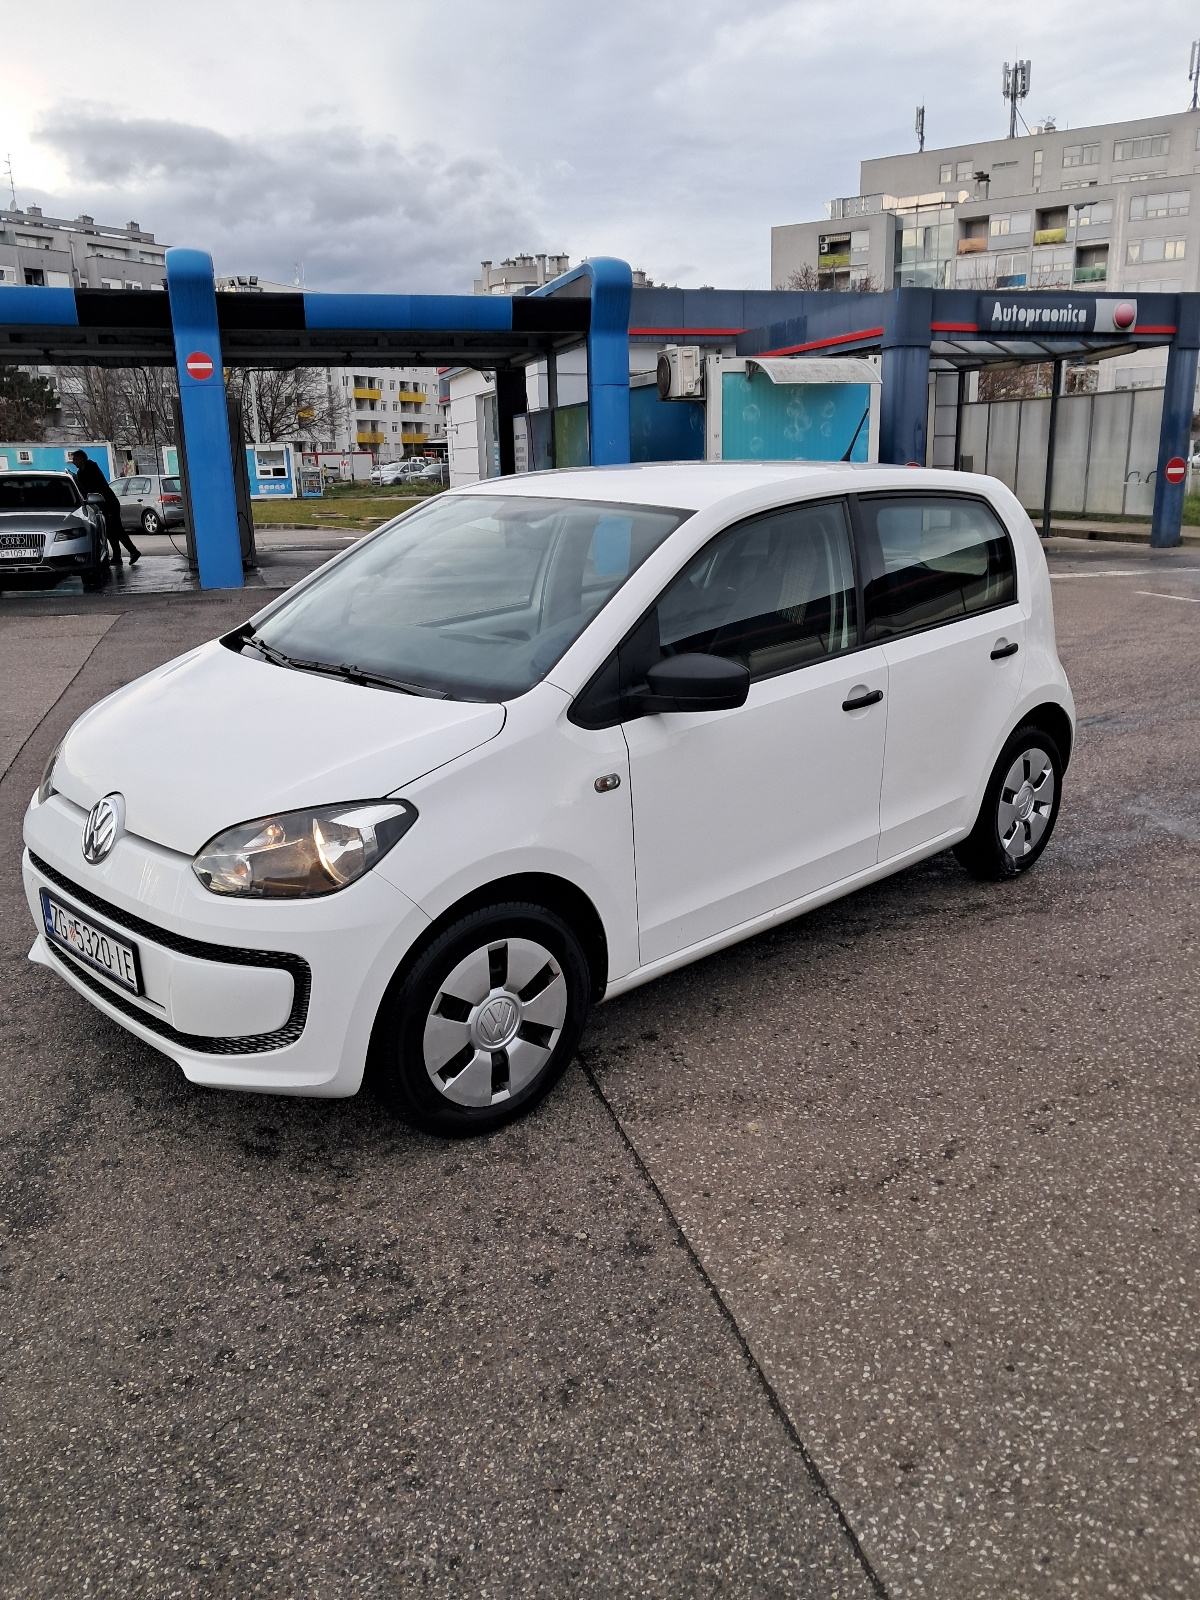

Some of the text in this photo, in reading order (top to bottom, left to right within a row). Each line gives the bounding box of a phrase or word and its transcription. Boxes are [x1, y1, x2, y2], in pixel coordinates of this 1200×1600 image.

[991, 301, 1087, 327] Autopraonica
[50, 903, 68, 941] ZG
[480, 1000, 516, 1042] VW
